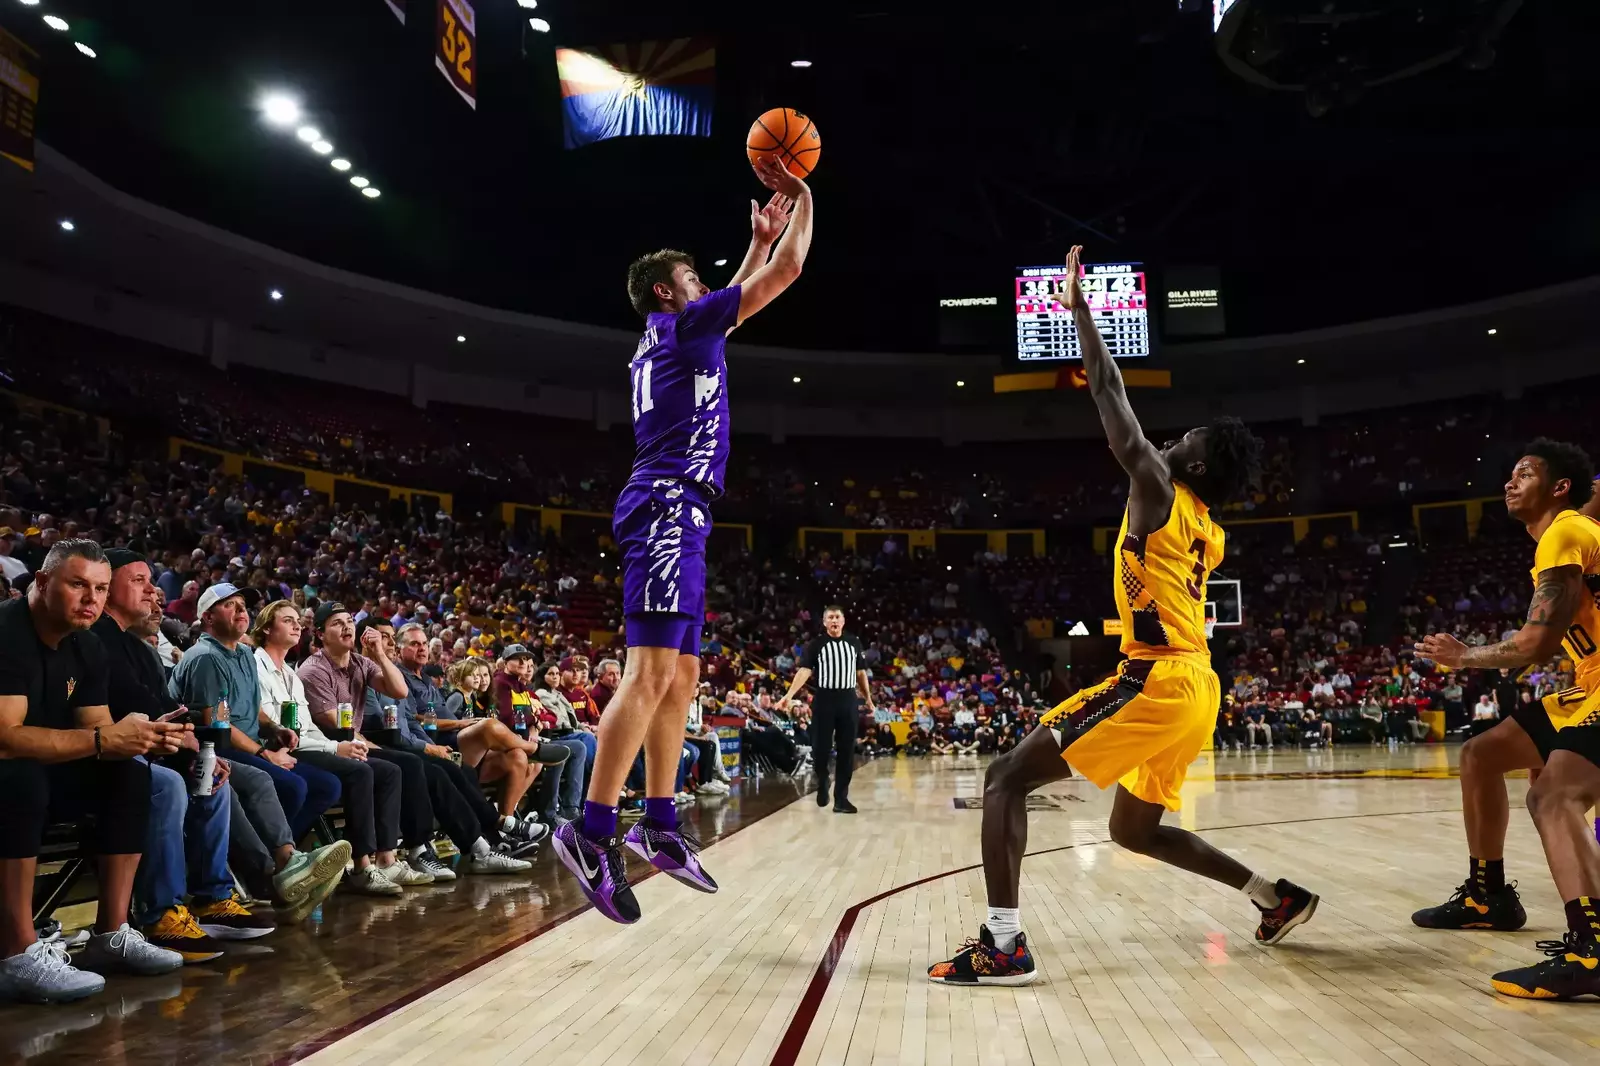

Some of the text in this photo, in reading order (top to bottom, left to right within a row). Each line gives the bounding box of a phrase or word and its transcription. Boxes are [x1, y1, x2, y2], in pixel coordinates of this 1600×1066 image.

[442, 5, 472, 85] 32
[1025, 280, 1050, 296] 35
[1111, 277, 1136, 292] 42
[1167, 289, 1217, 298] GILA RIVER
[939, 297, 998, 307] POWERADE
[631, 359, 654, 422] 11
[1186, 537, 1207, 601] 3
[1564, 623, 1598, 659] 10
